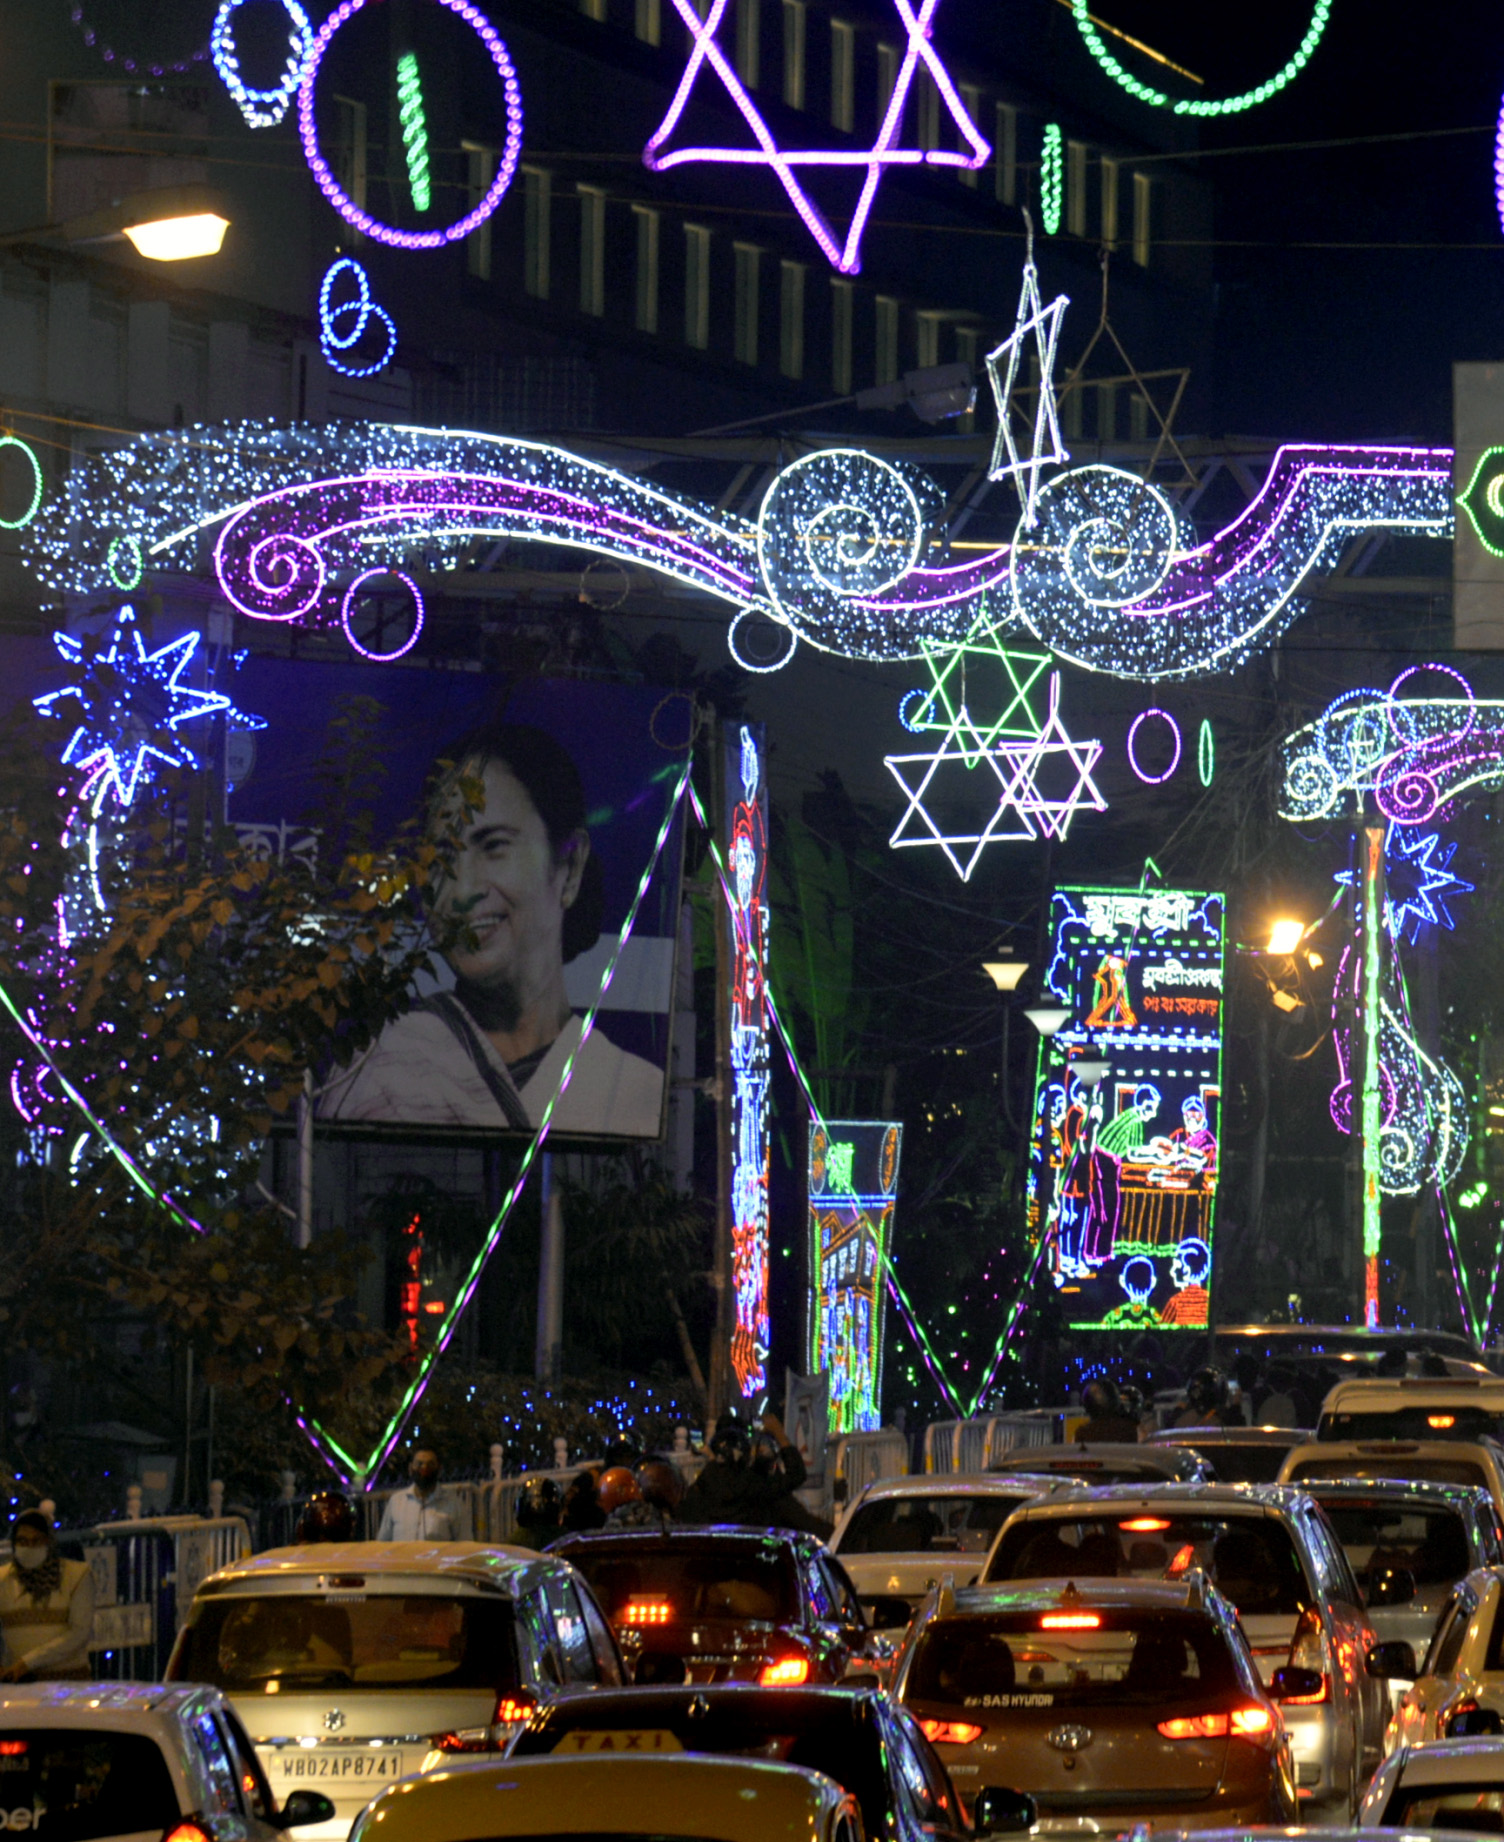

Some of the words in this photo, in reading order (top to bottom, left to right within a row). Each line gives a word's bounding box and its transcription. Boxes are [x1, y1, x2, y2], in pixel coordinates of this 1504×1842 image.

[983, 1694, 1010, 1708] SAS
[572, 1733, 663, 1751] TAXI
[283, 1756, 398, 1777] WB02AP8741
